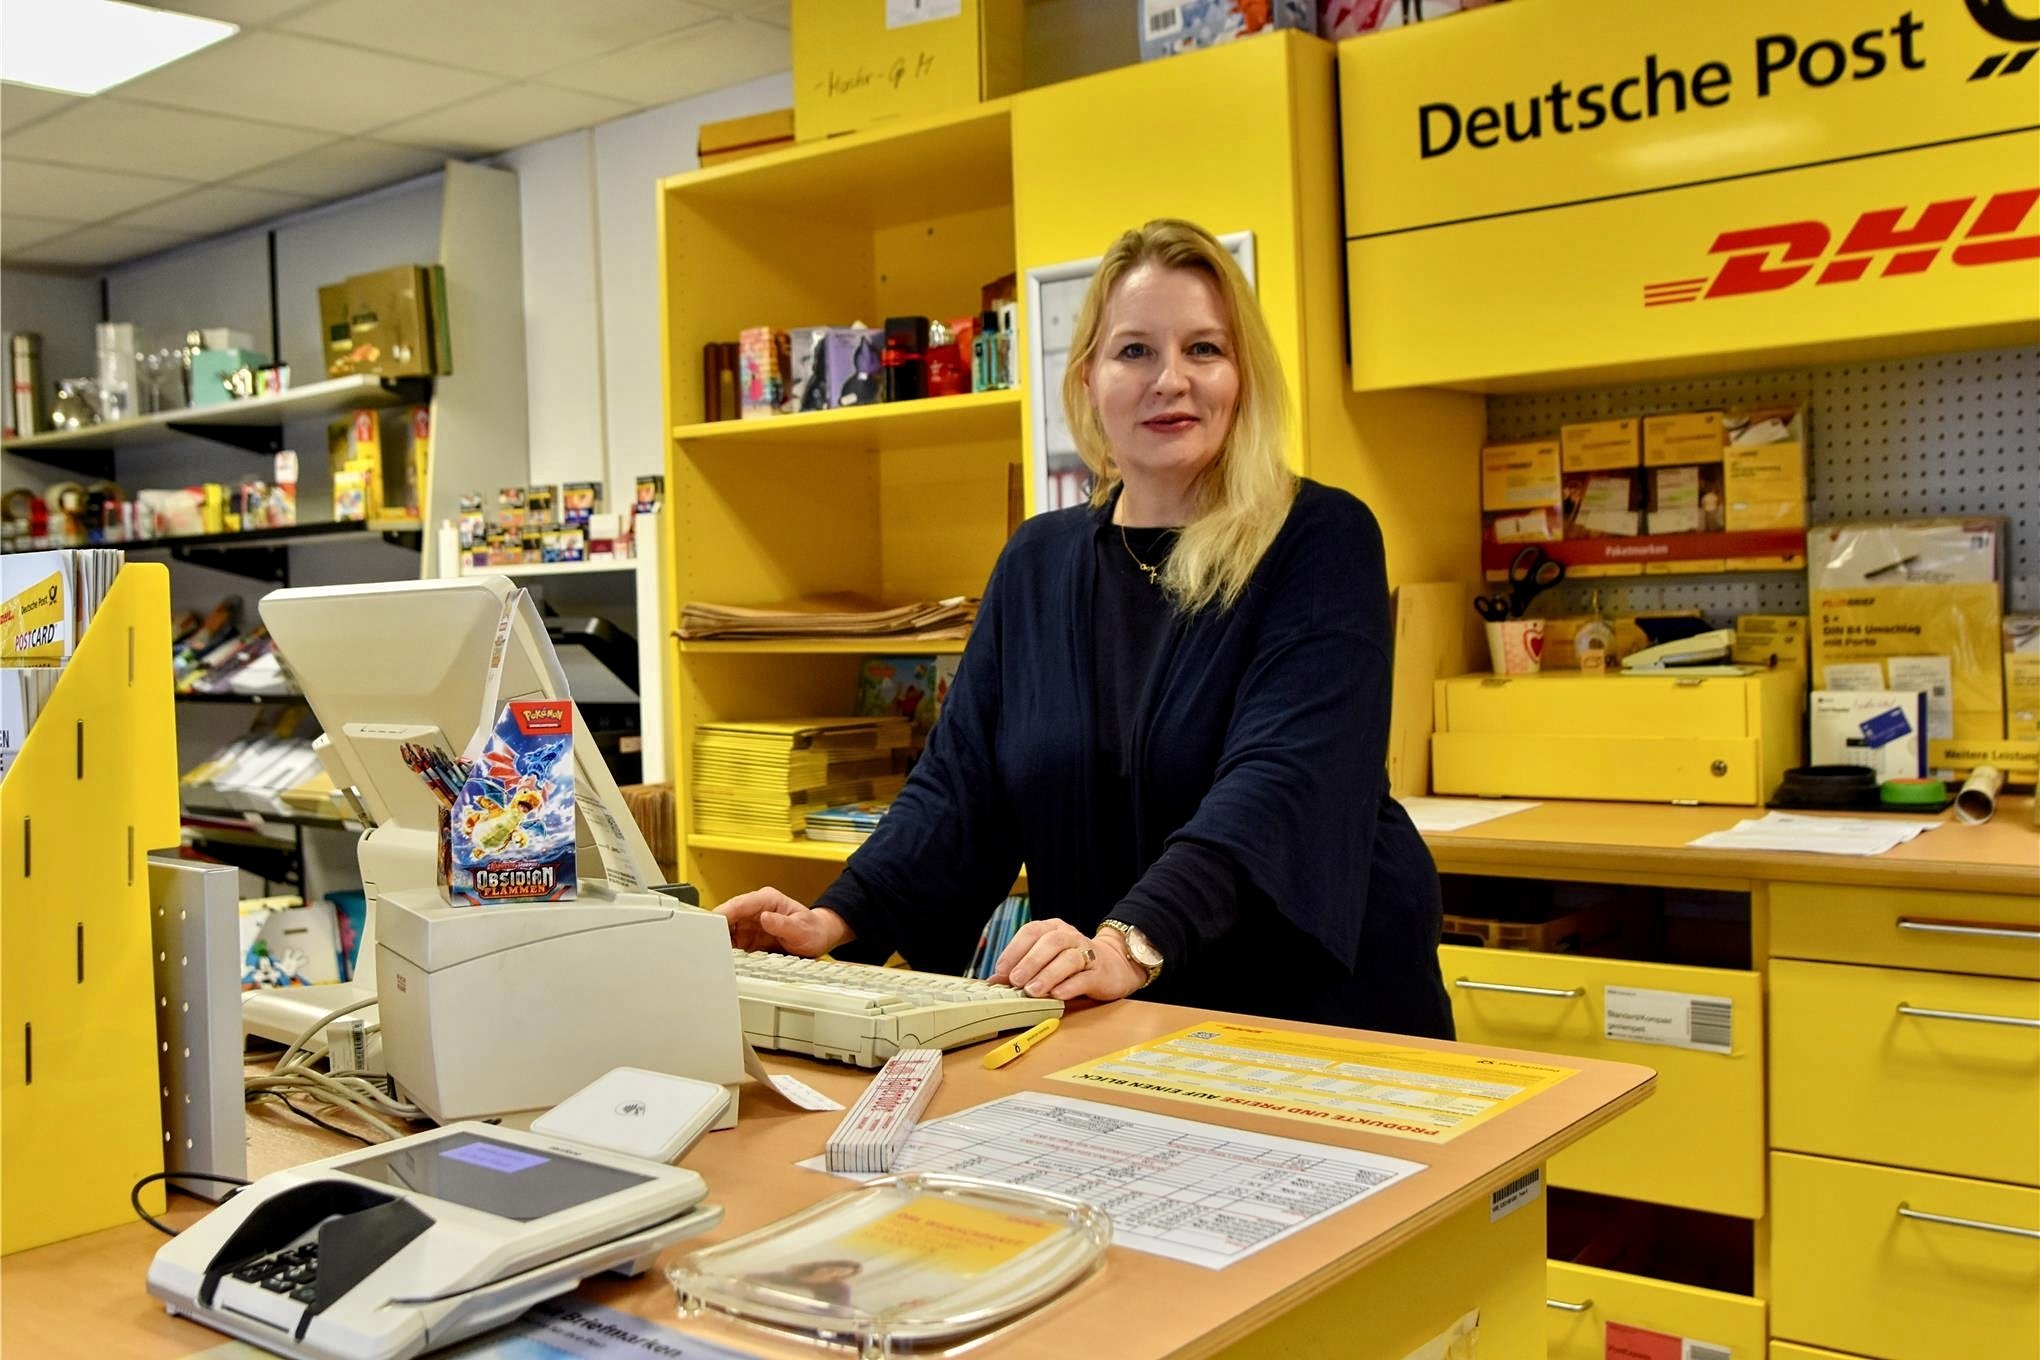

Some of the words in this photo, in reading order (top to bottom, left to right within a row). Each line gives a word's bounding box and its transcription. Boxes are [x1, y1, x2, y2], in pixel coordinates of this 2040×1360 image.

[1419, 53, 1732, 160] Deutsche
[1755, 11, 1926, 98] Post
[1703, 187, 2040, 300] DHL
[15, 624, 55, 652] POSTCARD
[1865, 623, 1921, 637] Umschlag
[1944, 749, 1989, 760] Weitere
[476, 866, 554, 891] OBSIDIAN
[483, 883, 546, 896] FLAMMEN
[1128, 1080, 1180, 1095] EINEN
[1182, 1091, 1223, 1101] AUF
[1222, 1096, 1286, 1112] PREISE
[1286, 1106, 1330, 1119] UND
[1330, 1112, 1440, 1136] PRODUKTE
[560, 1301, 683, 1358] Briefmarken
